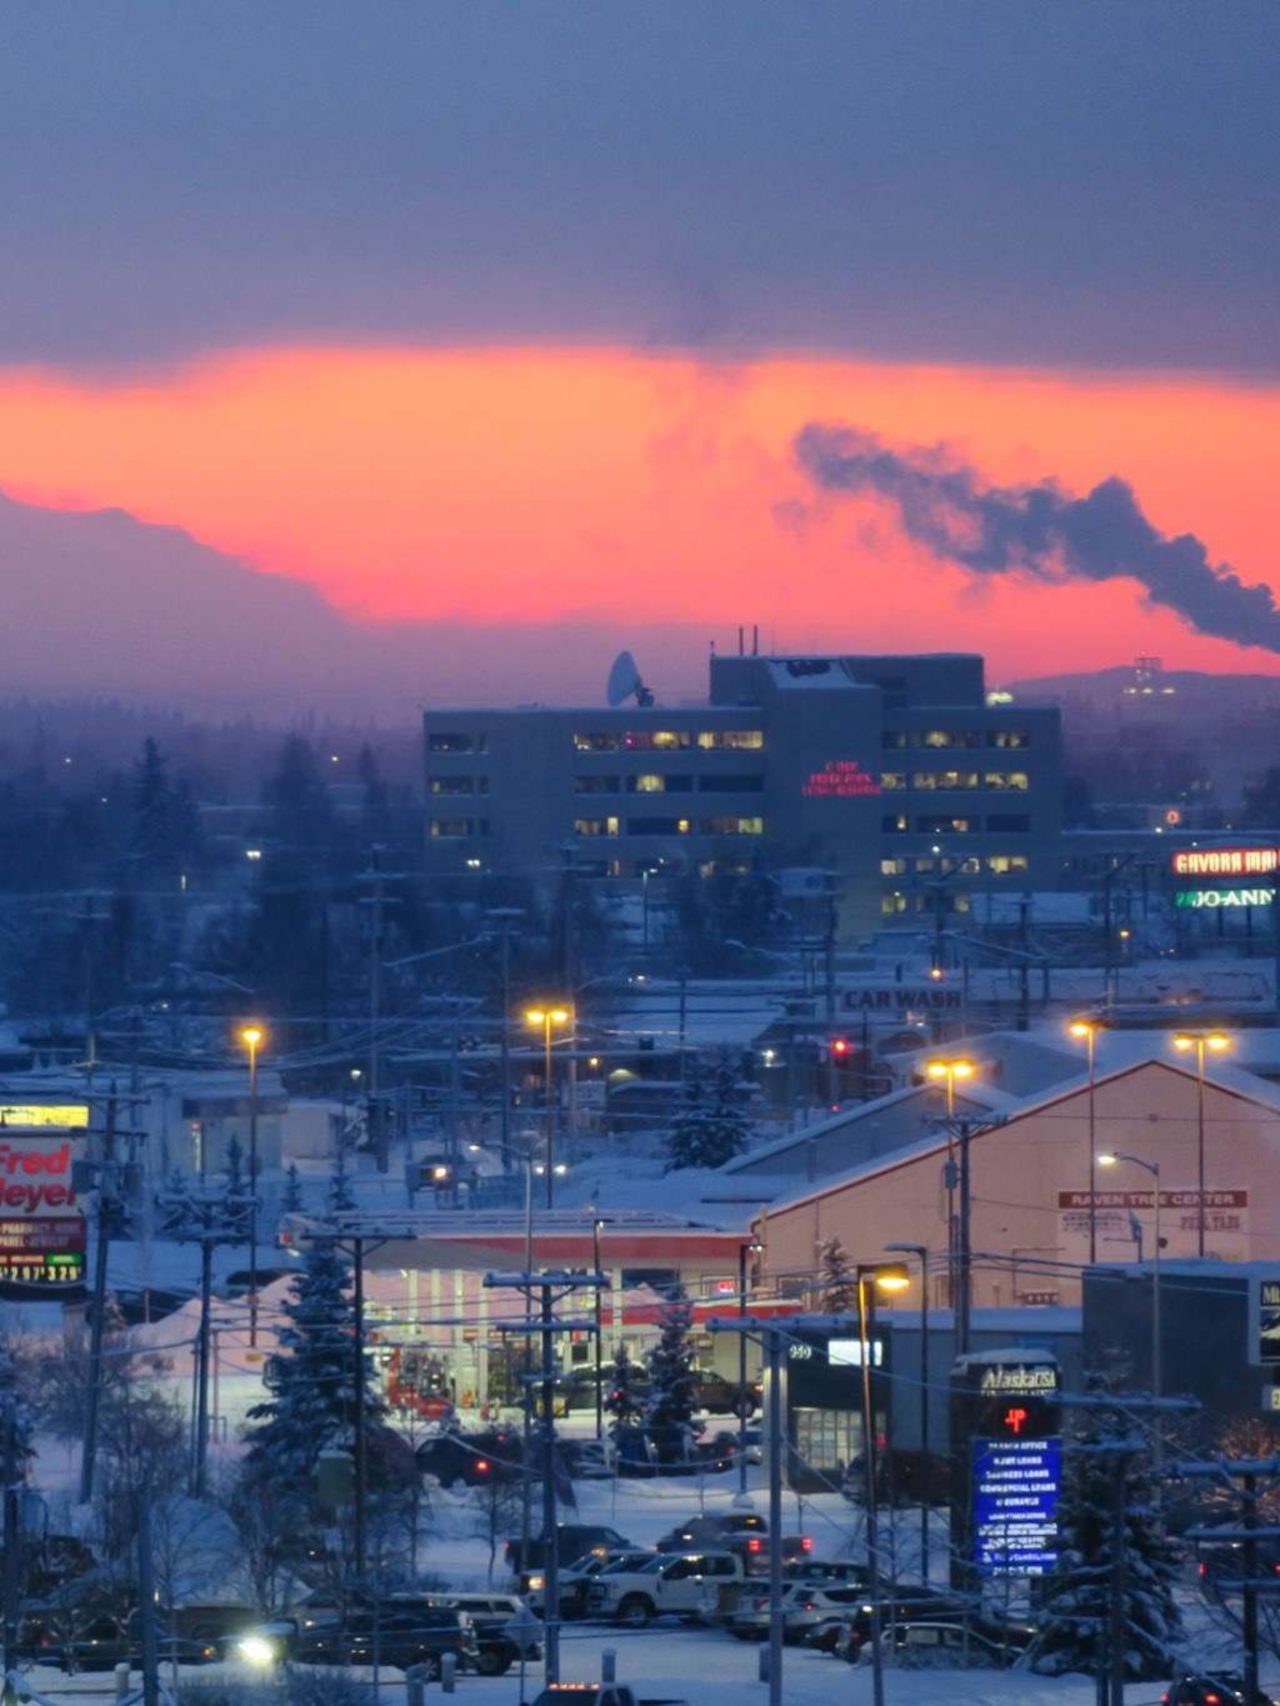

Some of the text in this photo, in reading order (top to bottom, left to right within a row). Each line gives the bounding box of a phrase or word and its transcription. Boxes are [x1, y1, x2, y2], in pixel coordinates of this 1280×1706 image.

[1176, 852, 1242, 874] GAVORA
[844, 990, 960, 1008] CAR WASH
